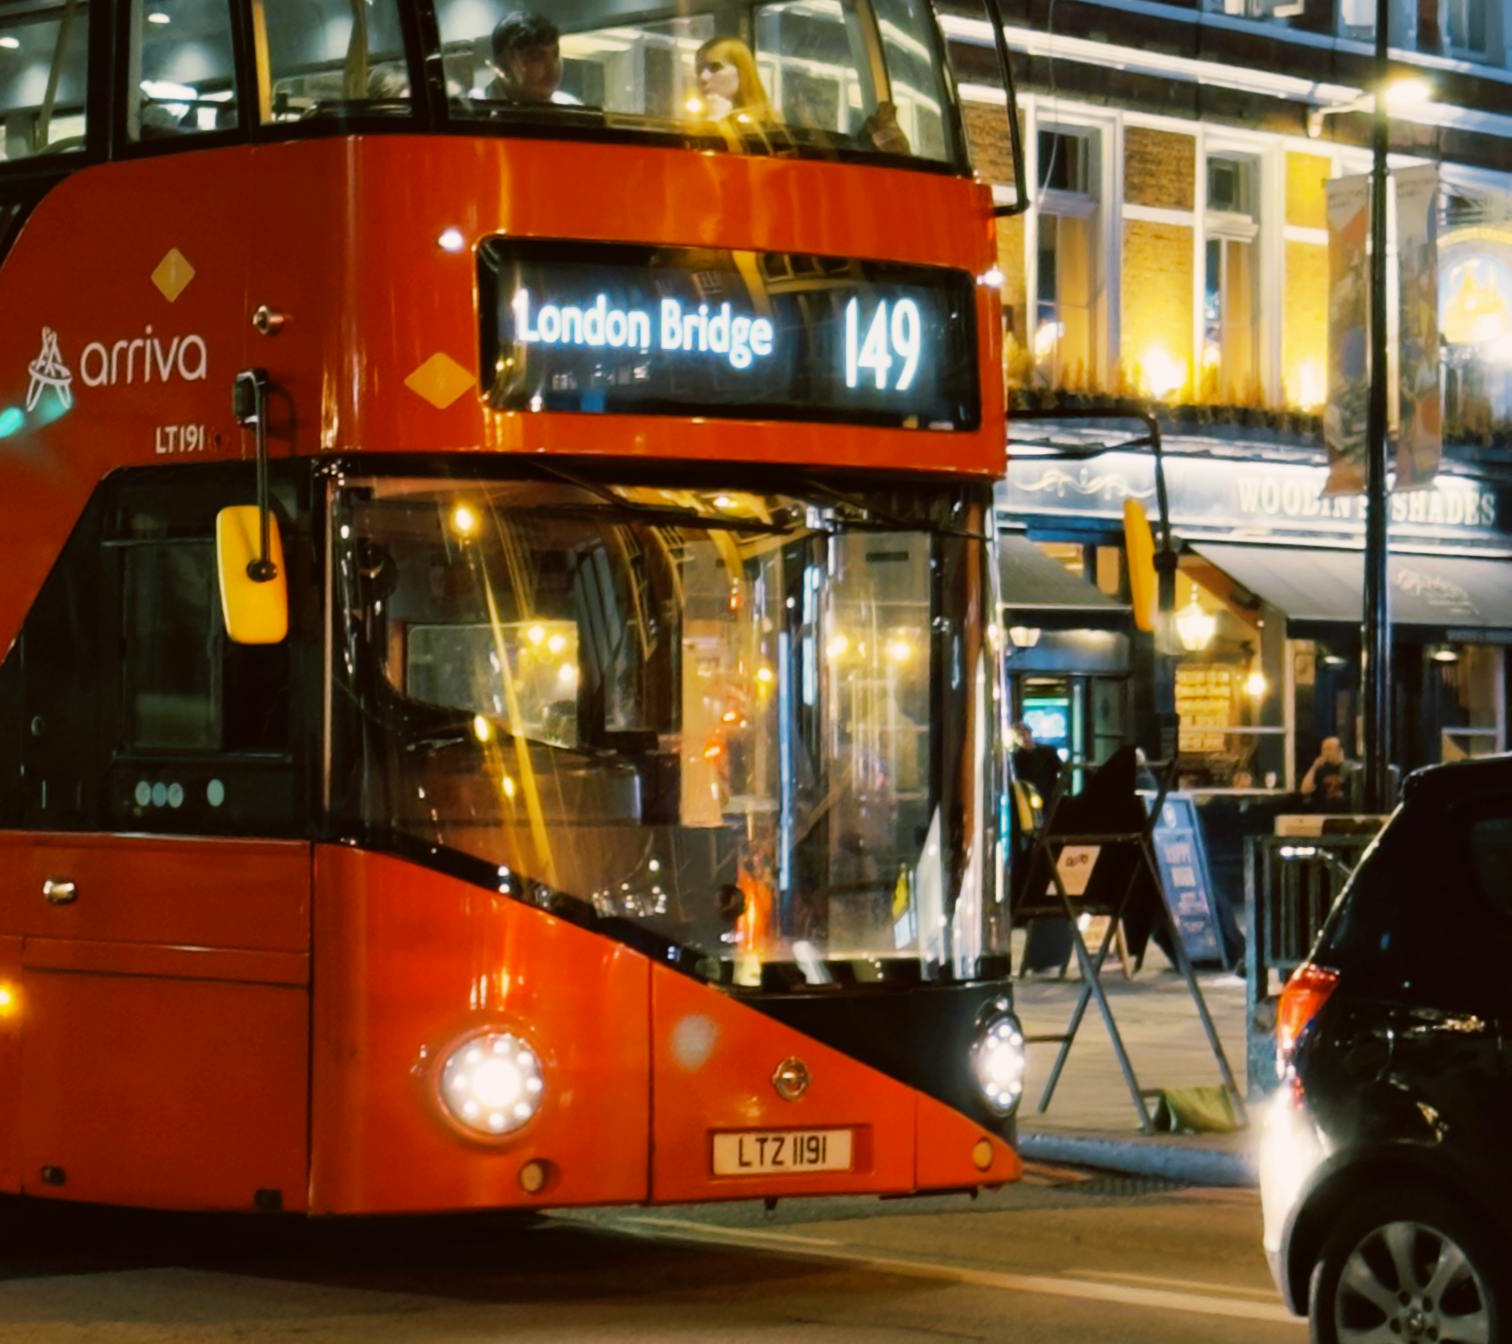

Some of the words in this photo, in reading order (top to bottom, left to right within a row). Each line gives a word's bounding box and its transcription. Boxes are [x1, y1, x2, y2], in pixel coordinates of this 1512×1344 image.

[80, 324, 207, 387] arriva
[517, 287, 650, 348] London
[660, 297, 774, 369] Bridge
[844, 296, 922, 392] 149
[155, 424, 205, 454] LT191
[1391, 490, 1496, 526] SHADES
[738, 1136, 786, 1167] LTZ
[792, 1135, 827, 1165] 1191
